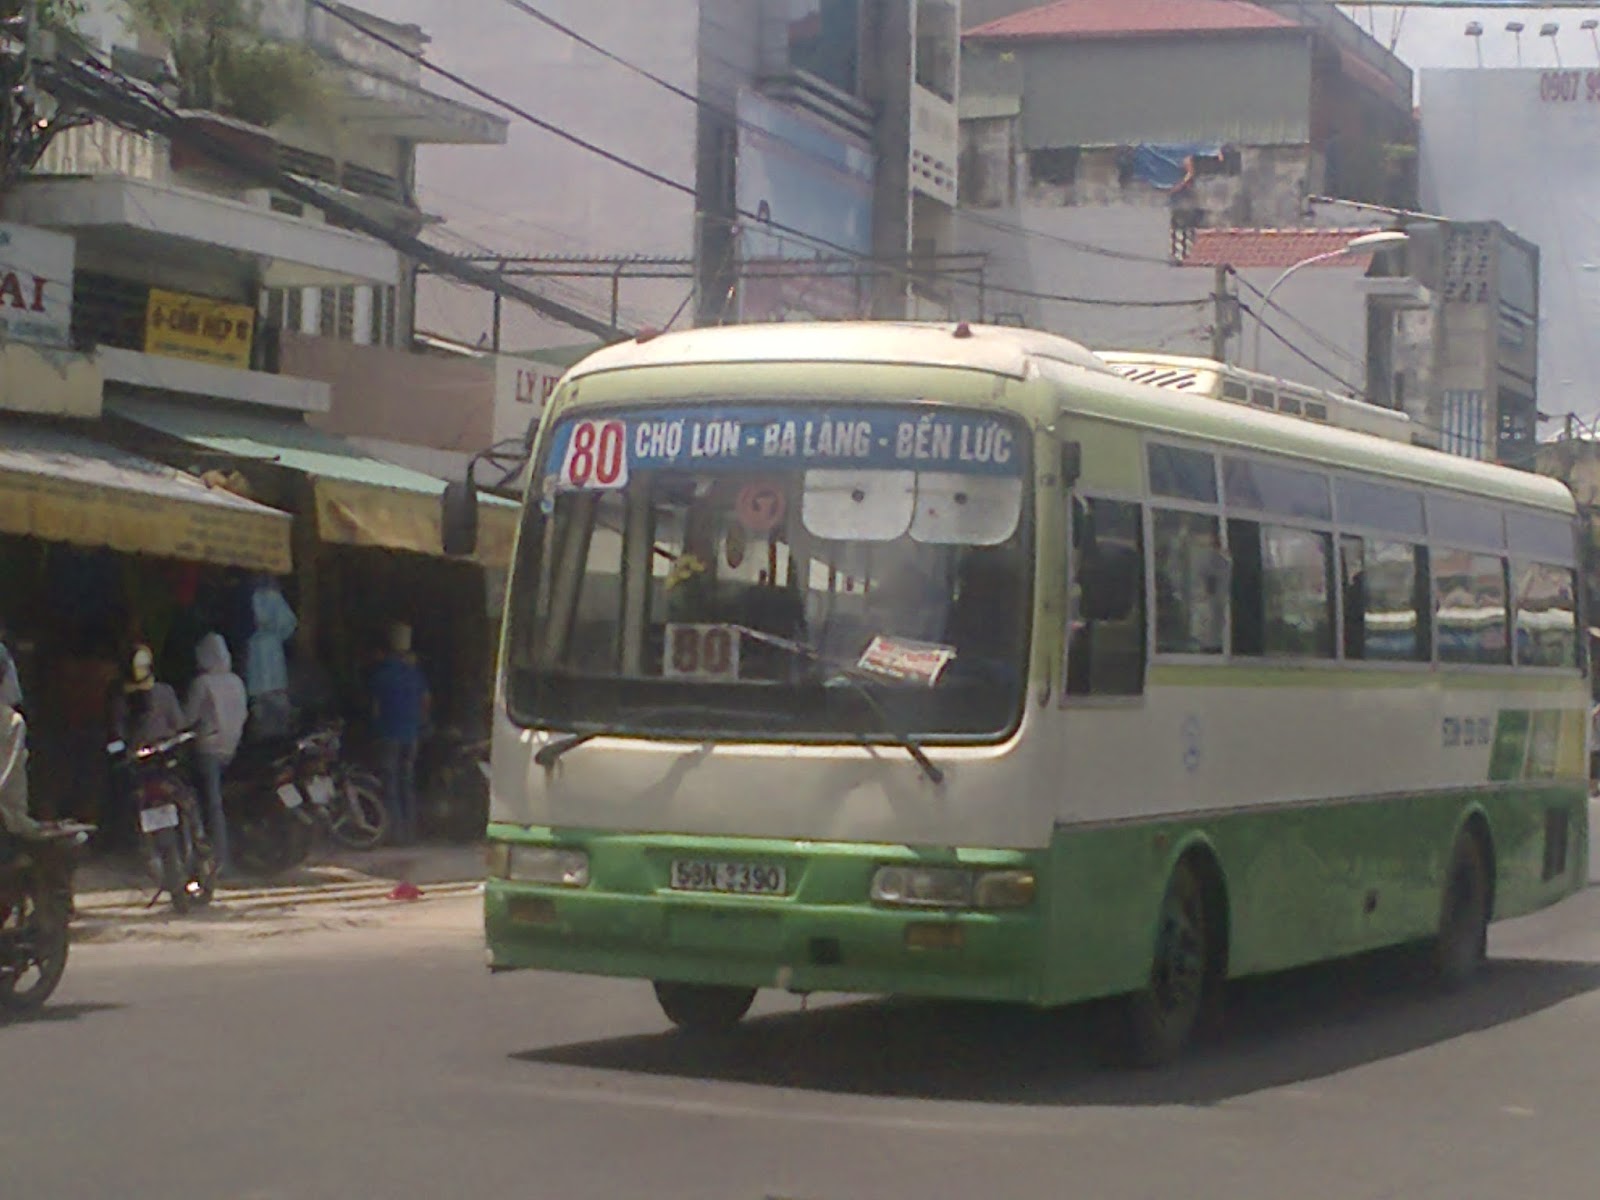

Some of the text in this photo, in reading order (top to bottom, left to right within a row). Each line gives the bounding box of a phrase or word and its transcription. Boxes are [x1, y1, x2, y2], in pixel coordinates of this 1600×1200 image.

[568, 421, 623, 486] 80
[634, 418, 686, 463] CHỢ
[763, 420, 796, 457] BA
[672, 627, 732, 673] 80
